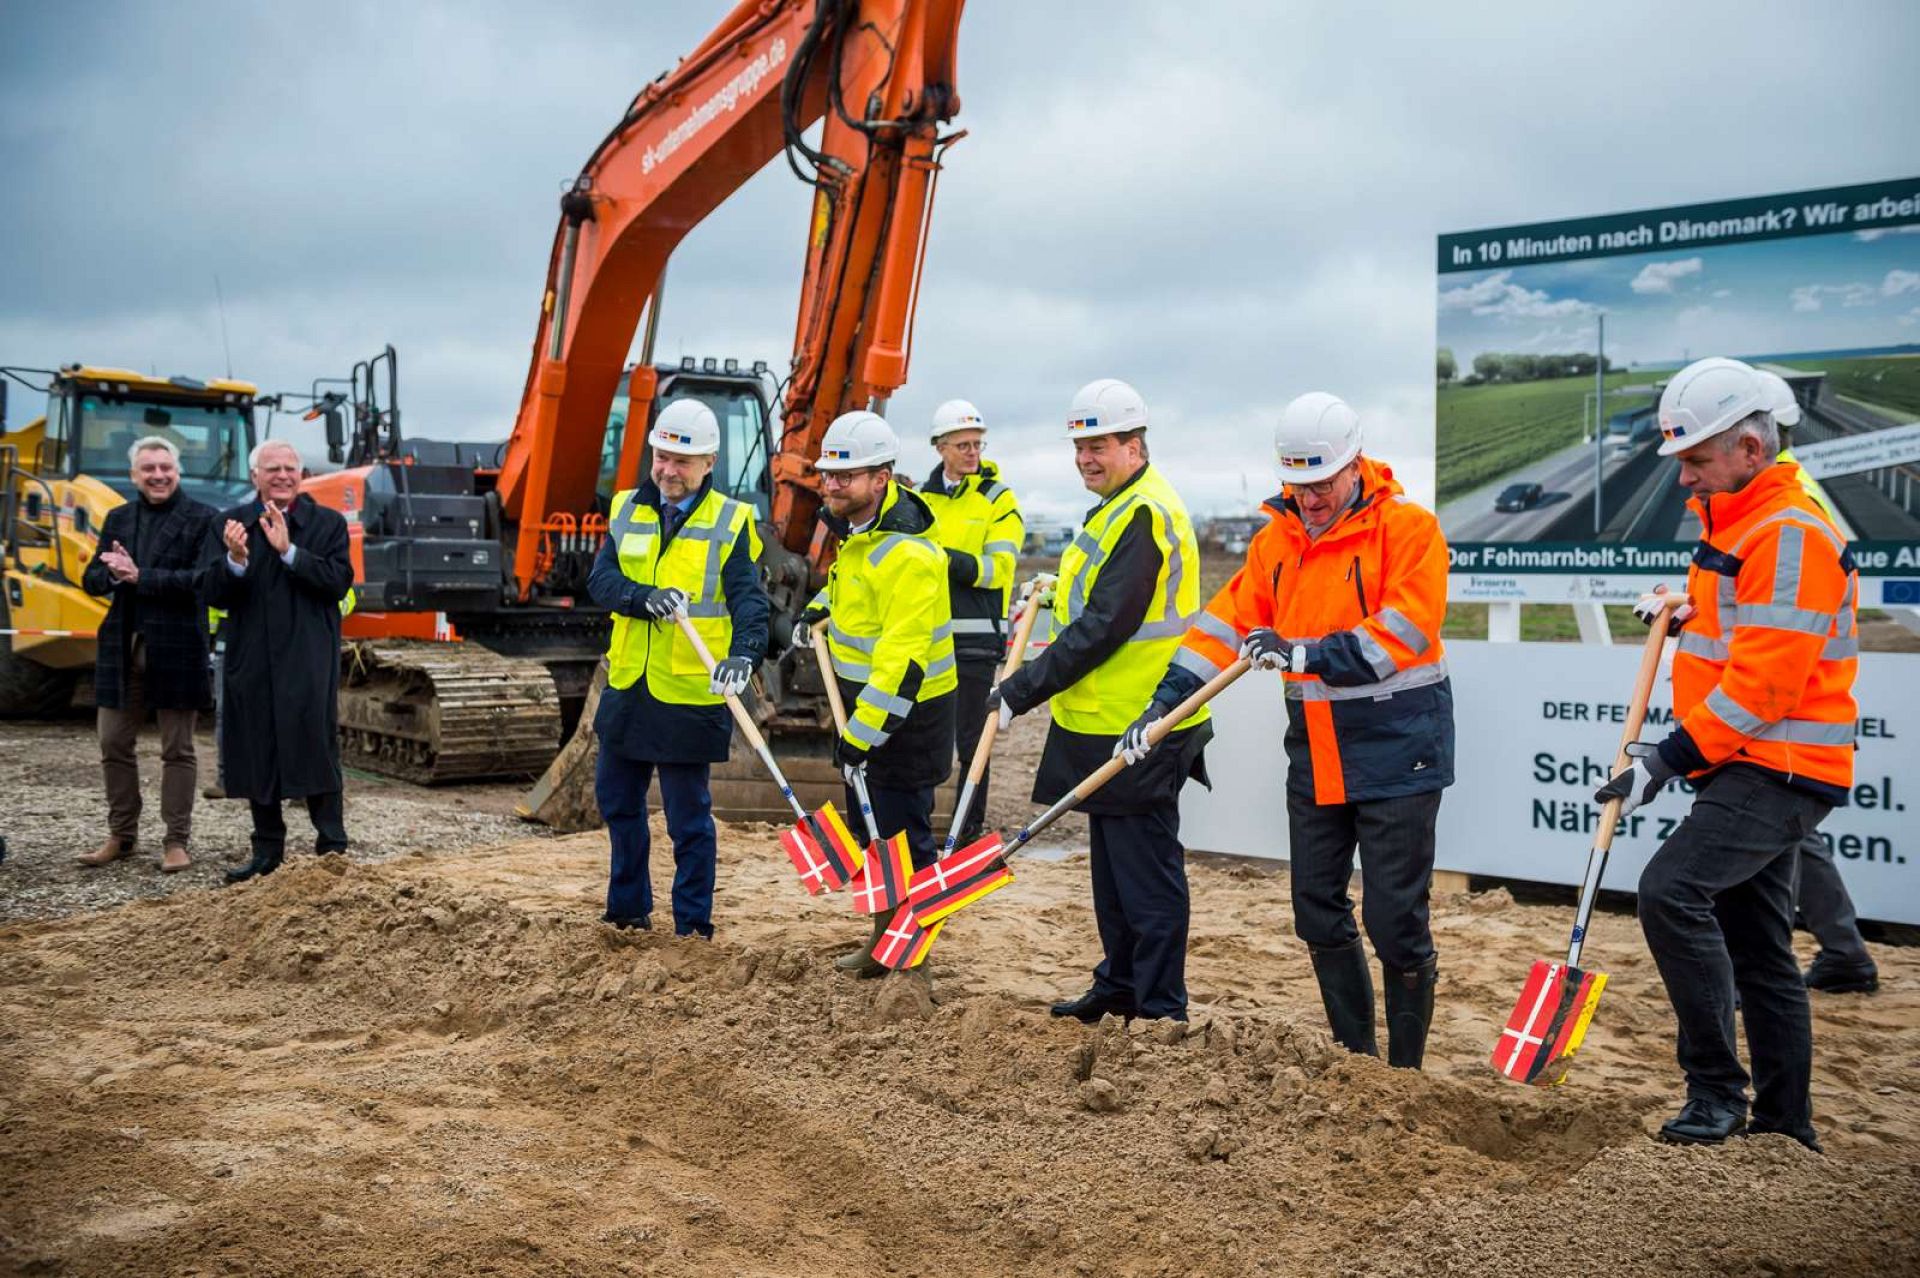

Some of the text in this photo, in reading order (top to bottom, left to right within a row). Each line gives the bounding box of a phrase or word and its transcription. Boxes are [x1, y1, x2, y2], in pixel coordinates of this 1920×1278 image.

[1453, 245, 1472, 265] In
[1477, 241, 1502, 262] 10
[1507, 234, 1592, 259] Minuten
[1598, 224, 1654, 249] nach
[1659, 207, 1797, 243] Dänemark?
[1803, 203, 1848, 227] Wir
[1543, 701, 1589, 721] DER
